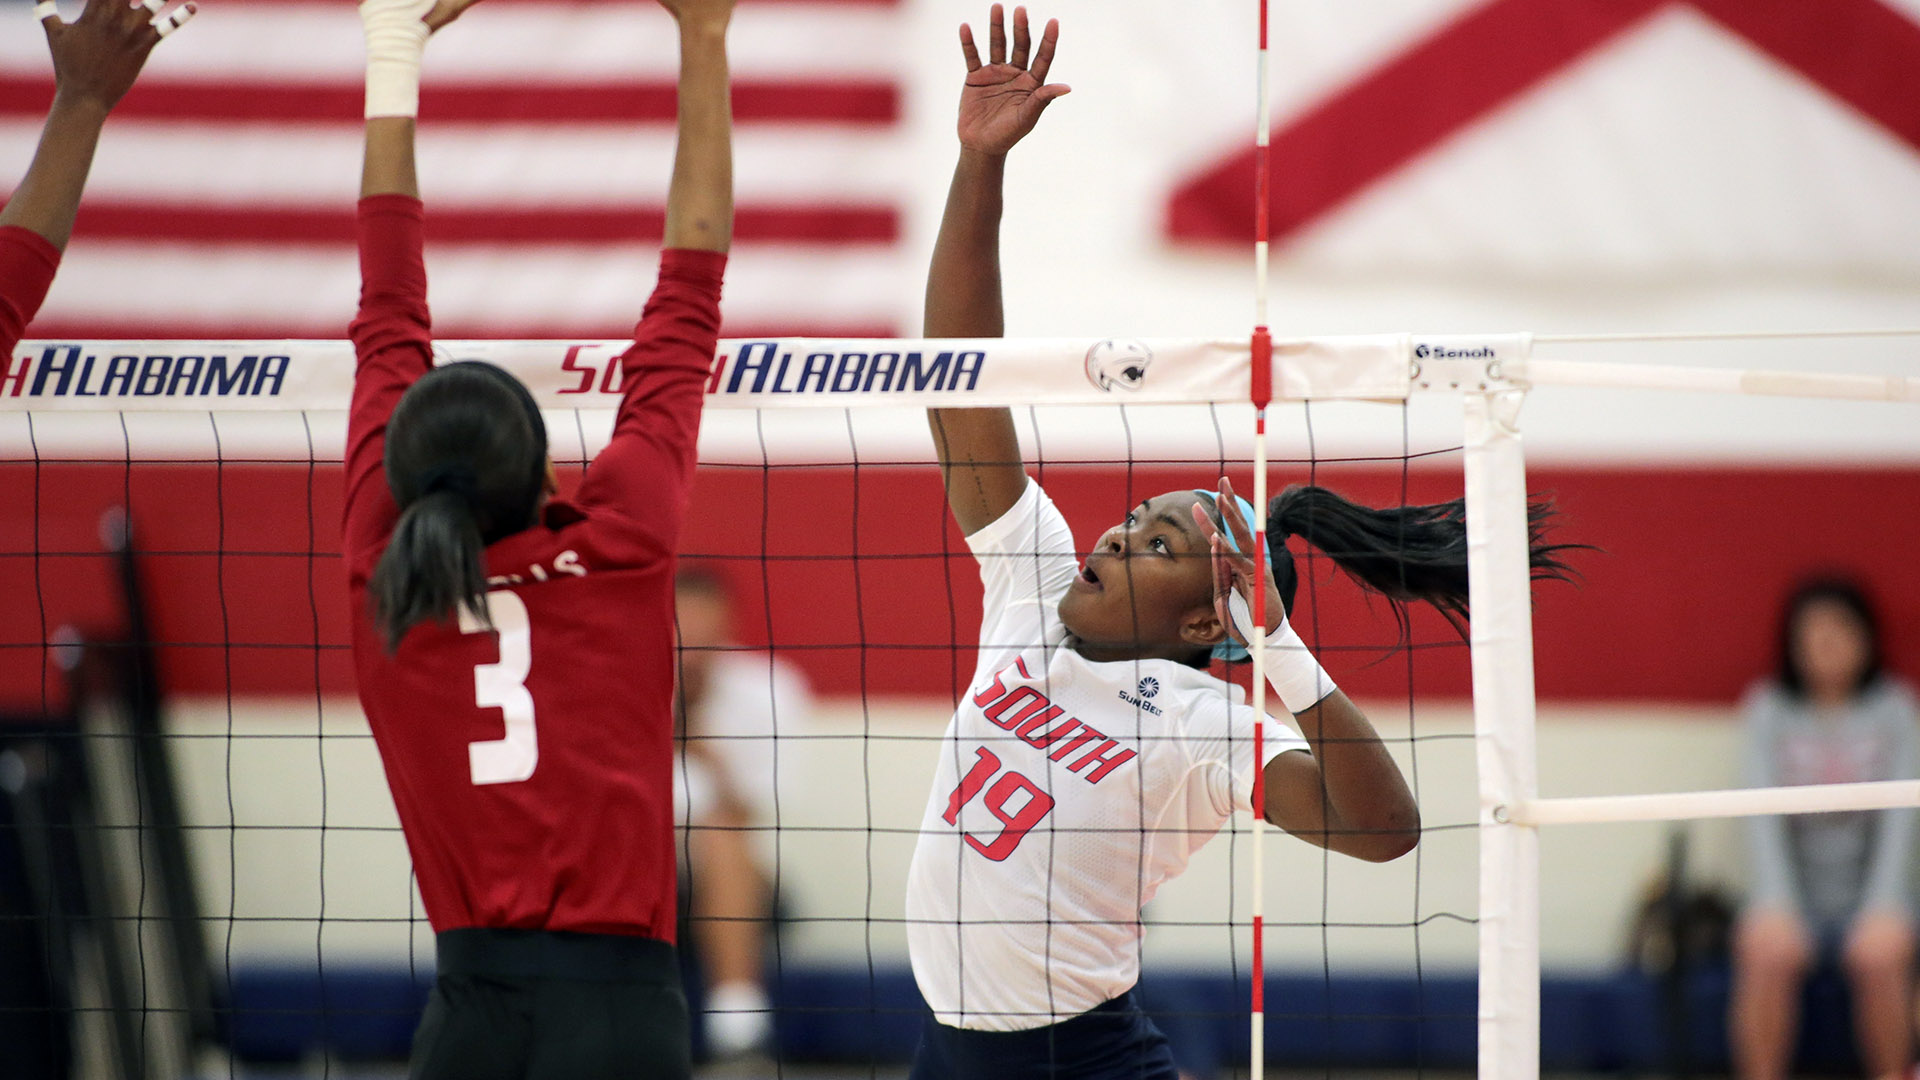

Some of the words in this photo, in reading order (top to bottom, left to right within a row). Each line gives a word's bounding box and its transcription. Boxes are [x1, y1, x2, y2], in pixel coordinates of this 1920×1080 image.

[1433, 345, 1494, 359] Senoh
[458, 590, 539, 785] 3
[973, 655, 1138, 784] SOUTH
[941, 746, 1055, 862] 19
